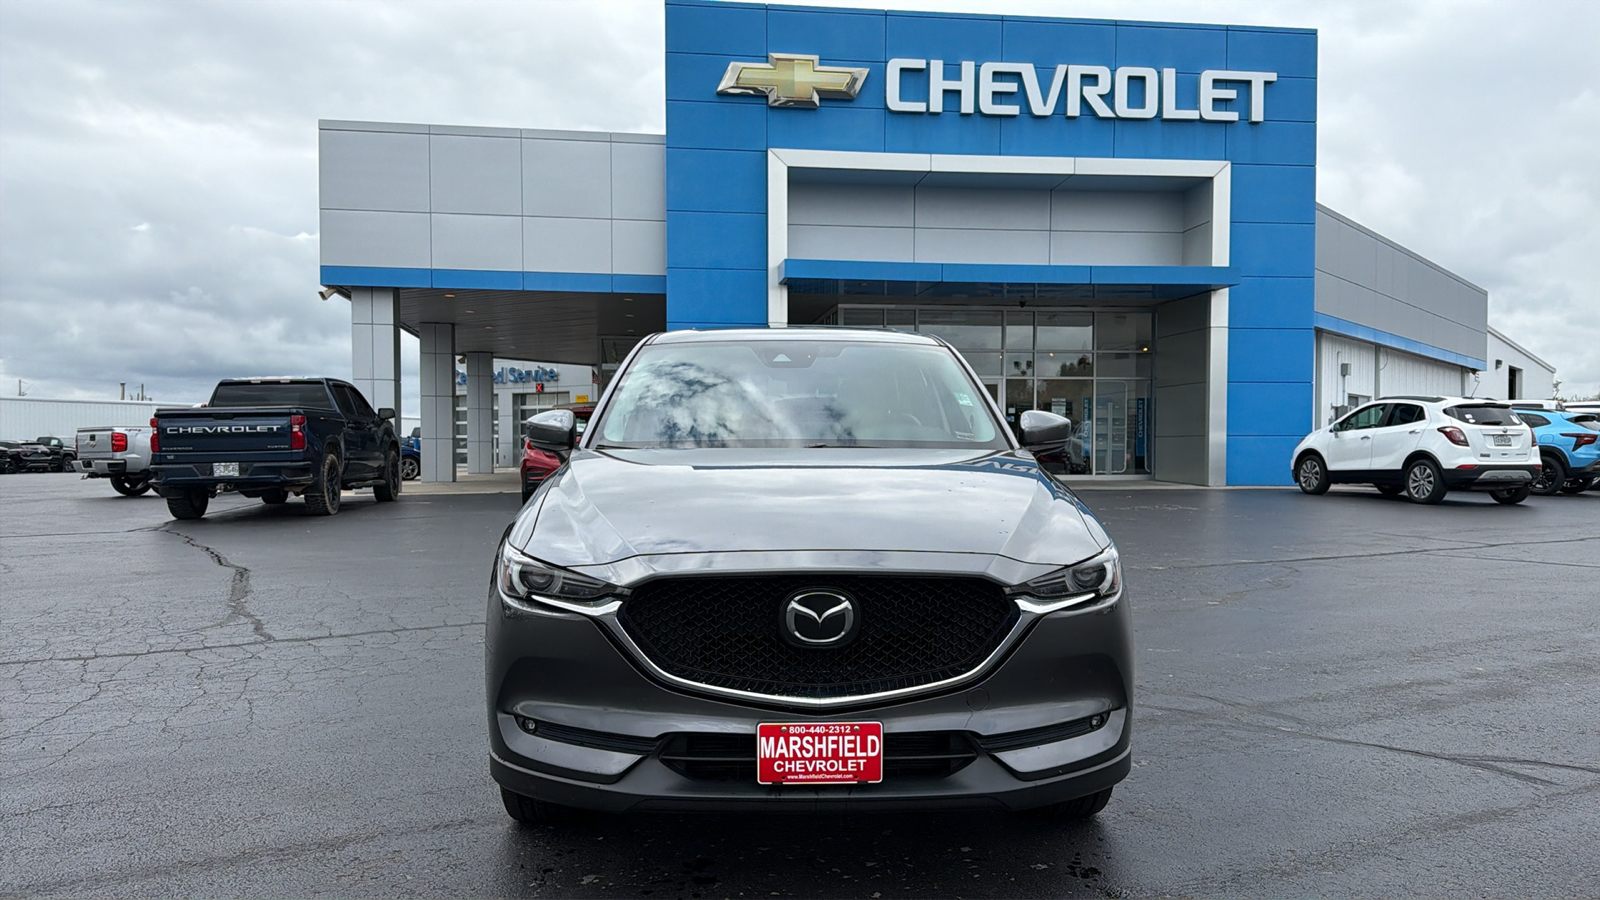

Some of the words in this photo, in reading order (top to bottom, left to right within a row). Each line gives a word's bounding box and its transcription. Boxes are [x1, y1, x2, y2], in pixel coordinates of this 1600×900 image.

[886, 58, 1278, 122] CHEVROLET
[508, 365, 557, 383] Service
[166, 425, 281, 434] CHEVROLET
[789, 726, 851, 734] 800-440-2312
[760, 735, 880, 758] MARSHFIELD
[773, 760, 867, 772] CHEVROLET
